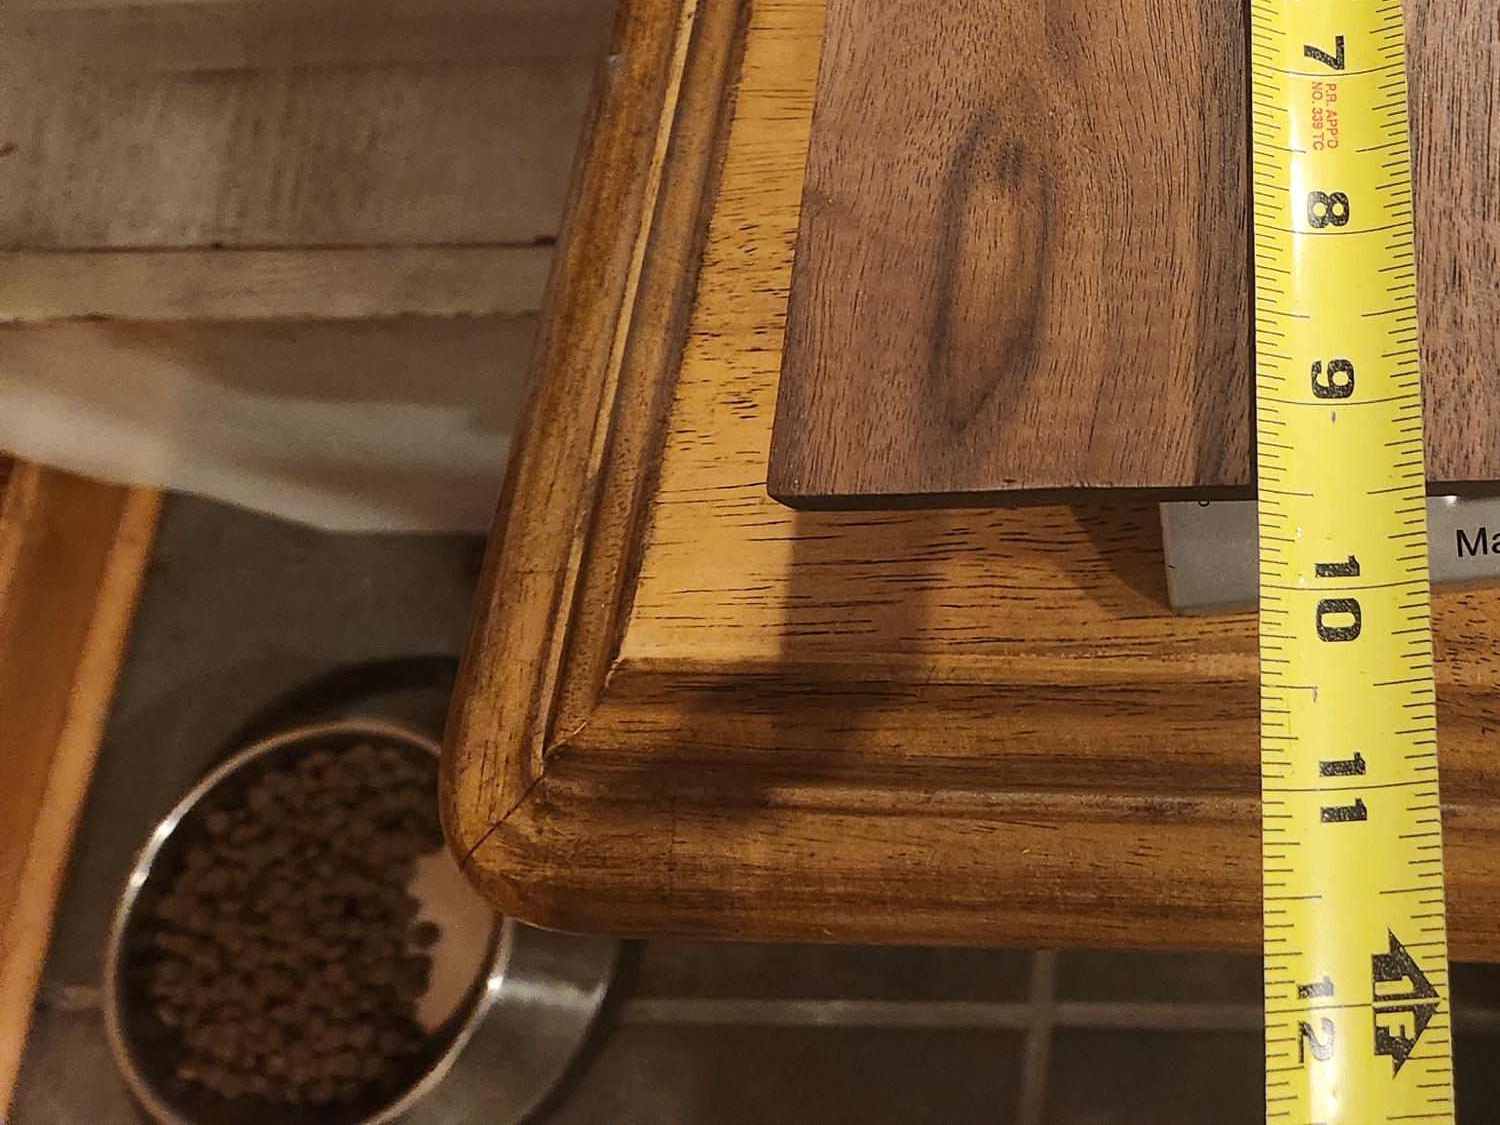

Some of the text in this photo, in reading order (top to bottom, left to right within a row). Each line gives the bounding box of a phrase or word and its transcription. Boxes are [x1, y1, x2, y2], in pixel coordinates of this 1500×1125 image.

[1303, 35, 1346, 71] 7
[1307, 191, 1350, 228] 8
[1311, 359, 1354, 399] 9
[1315, 554, 1361, 642] 10
[1319, 752, 1368, 823] 11
[1297, 976, 1334, 1064] 12
